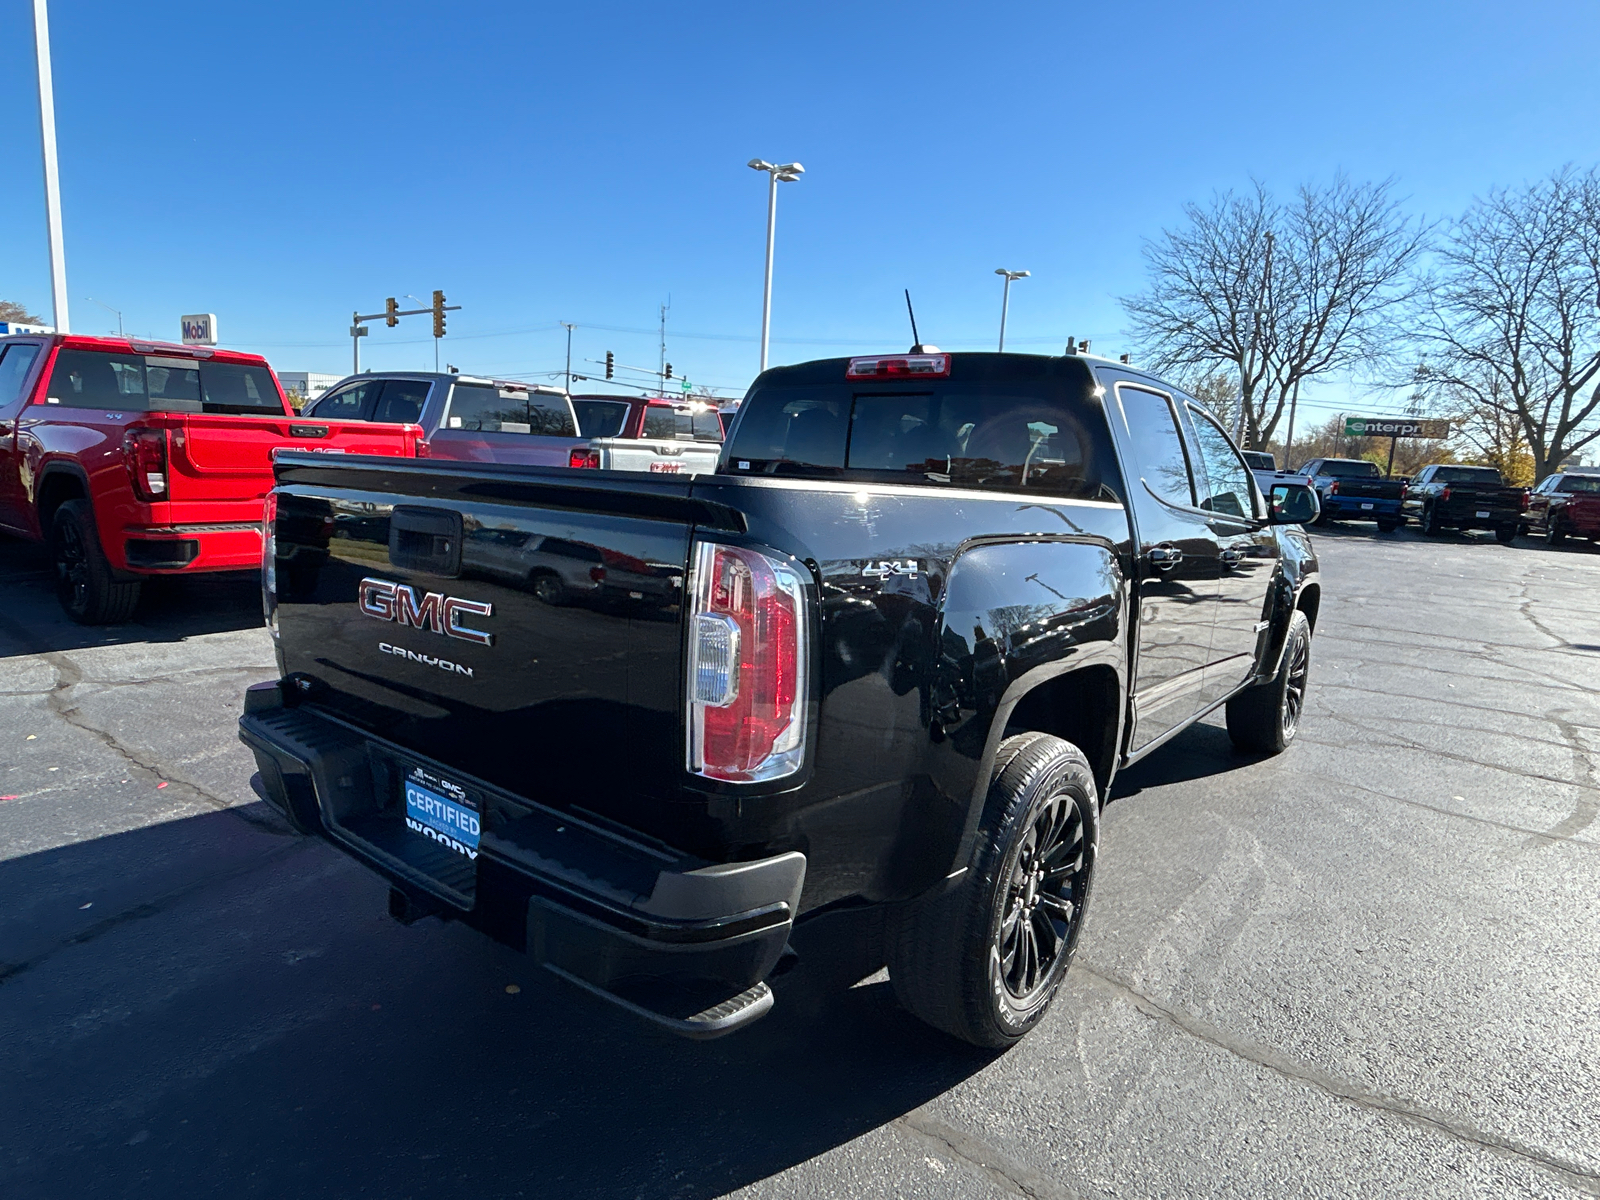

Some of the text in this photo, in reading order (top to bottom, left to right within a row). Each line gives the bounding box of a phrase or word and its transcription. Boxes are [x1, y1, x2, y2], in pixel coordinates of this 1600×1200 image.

[183, 320, 209, 339] Mobil
[358, 577, 492, 646] GMC
[378, 642, 474, 678] CANYON
[407, 789, 480, 836] CERTIFIED
[405, 817, 478, 860] WOODY
